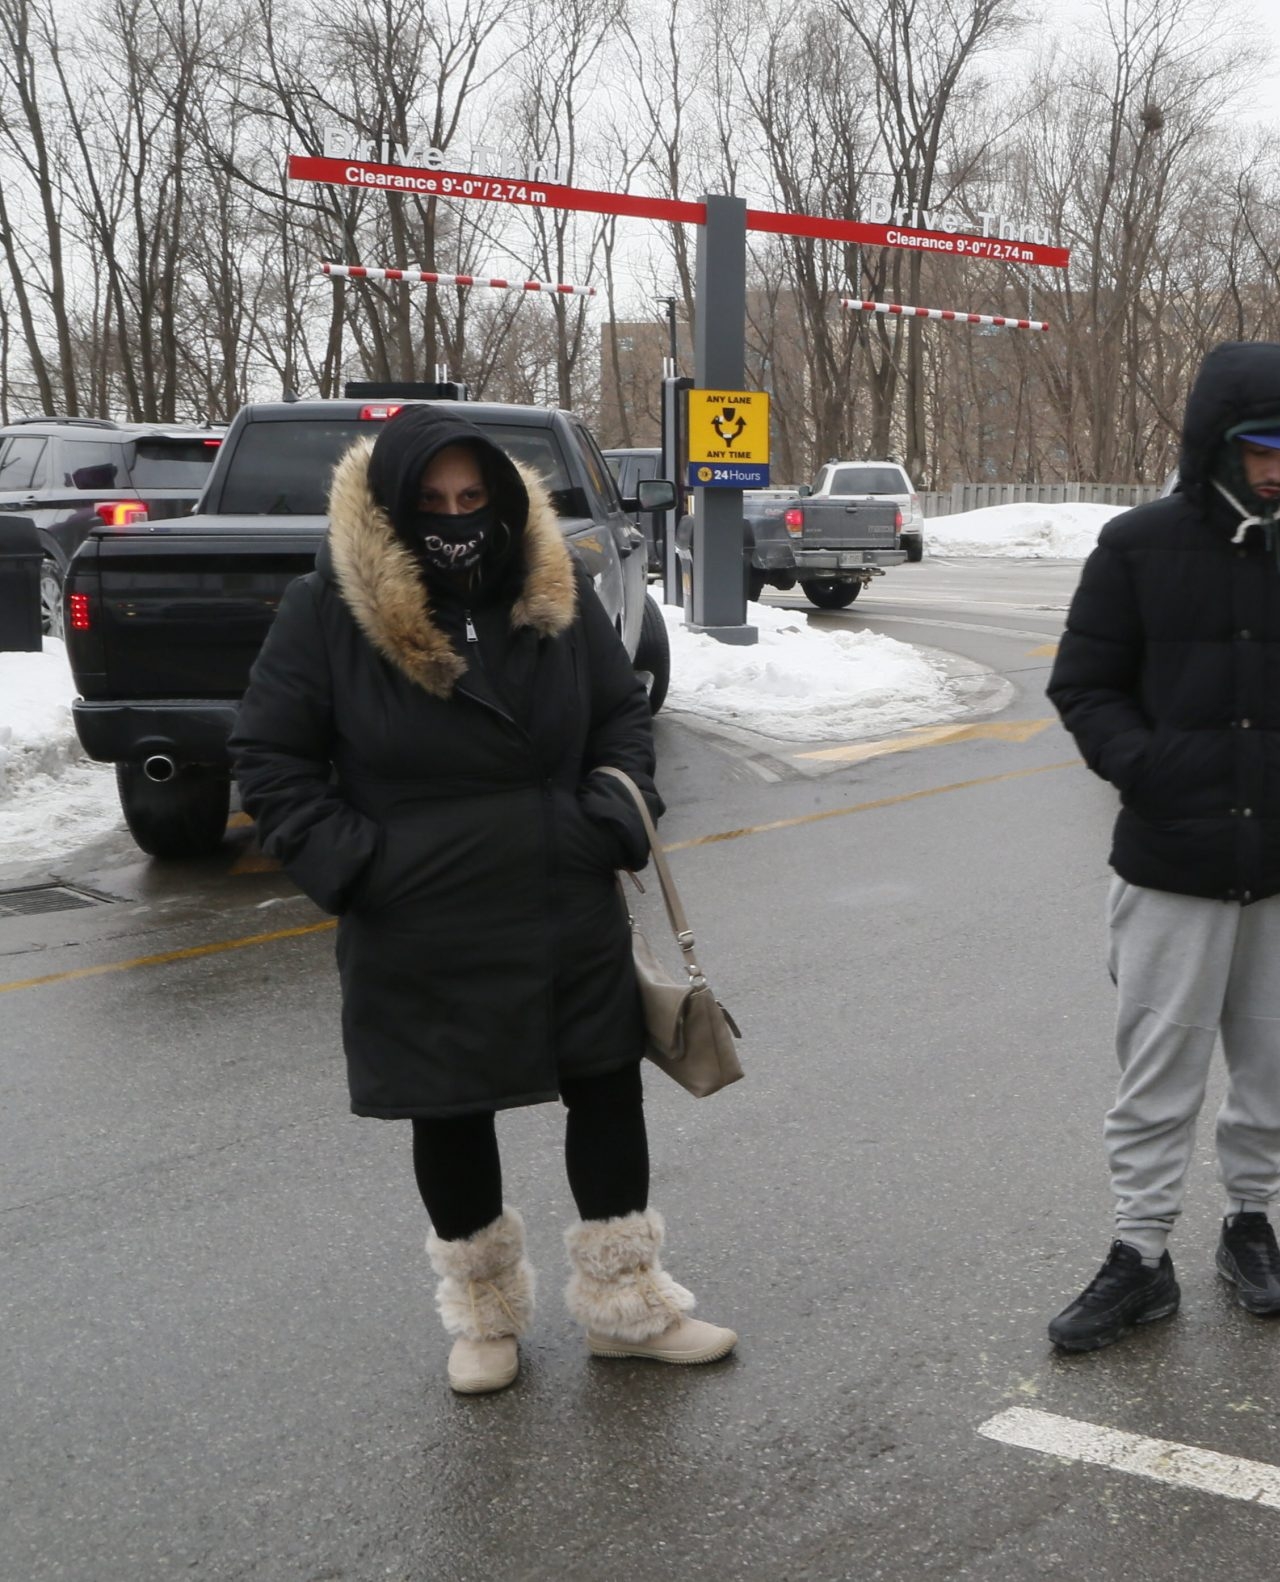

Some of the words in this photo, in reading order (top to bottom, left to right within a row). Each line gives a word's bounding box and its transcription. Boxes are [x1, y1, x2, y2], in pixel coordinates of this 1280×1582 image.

[324, 126, 568, 186] Drive-Thru
[345, 167, 437, 191] Clearance
[530, 191, 546, 203] m
[870, 197, 1049, 245] Drive-Thru
[886, 230, 953, 251] Clearance
[1021, 250, 1034, 261] m
[706, 395, 726, 404] ANY
[728, 396, 752, 404] LANE
[706, 450, 726, 458] ANY
[729, 451, 752, 459] TIME
[714, 469, 729, 480] 24
[729, 470, 761, 481] Hours
